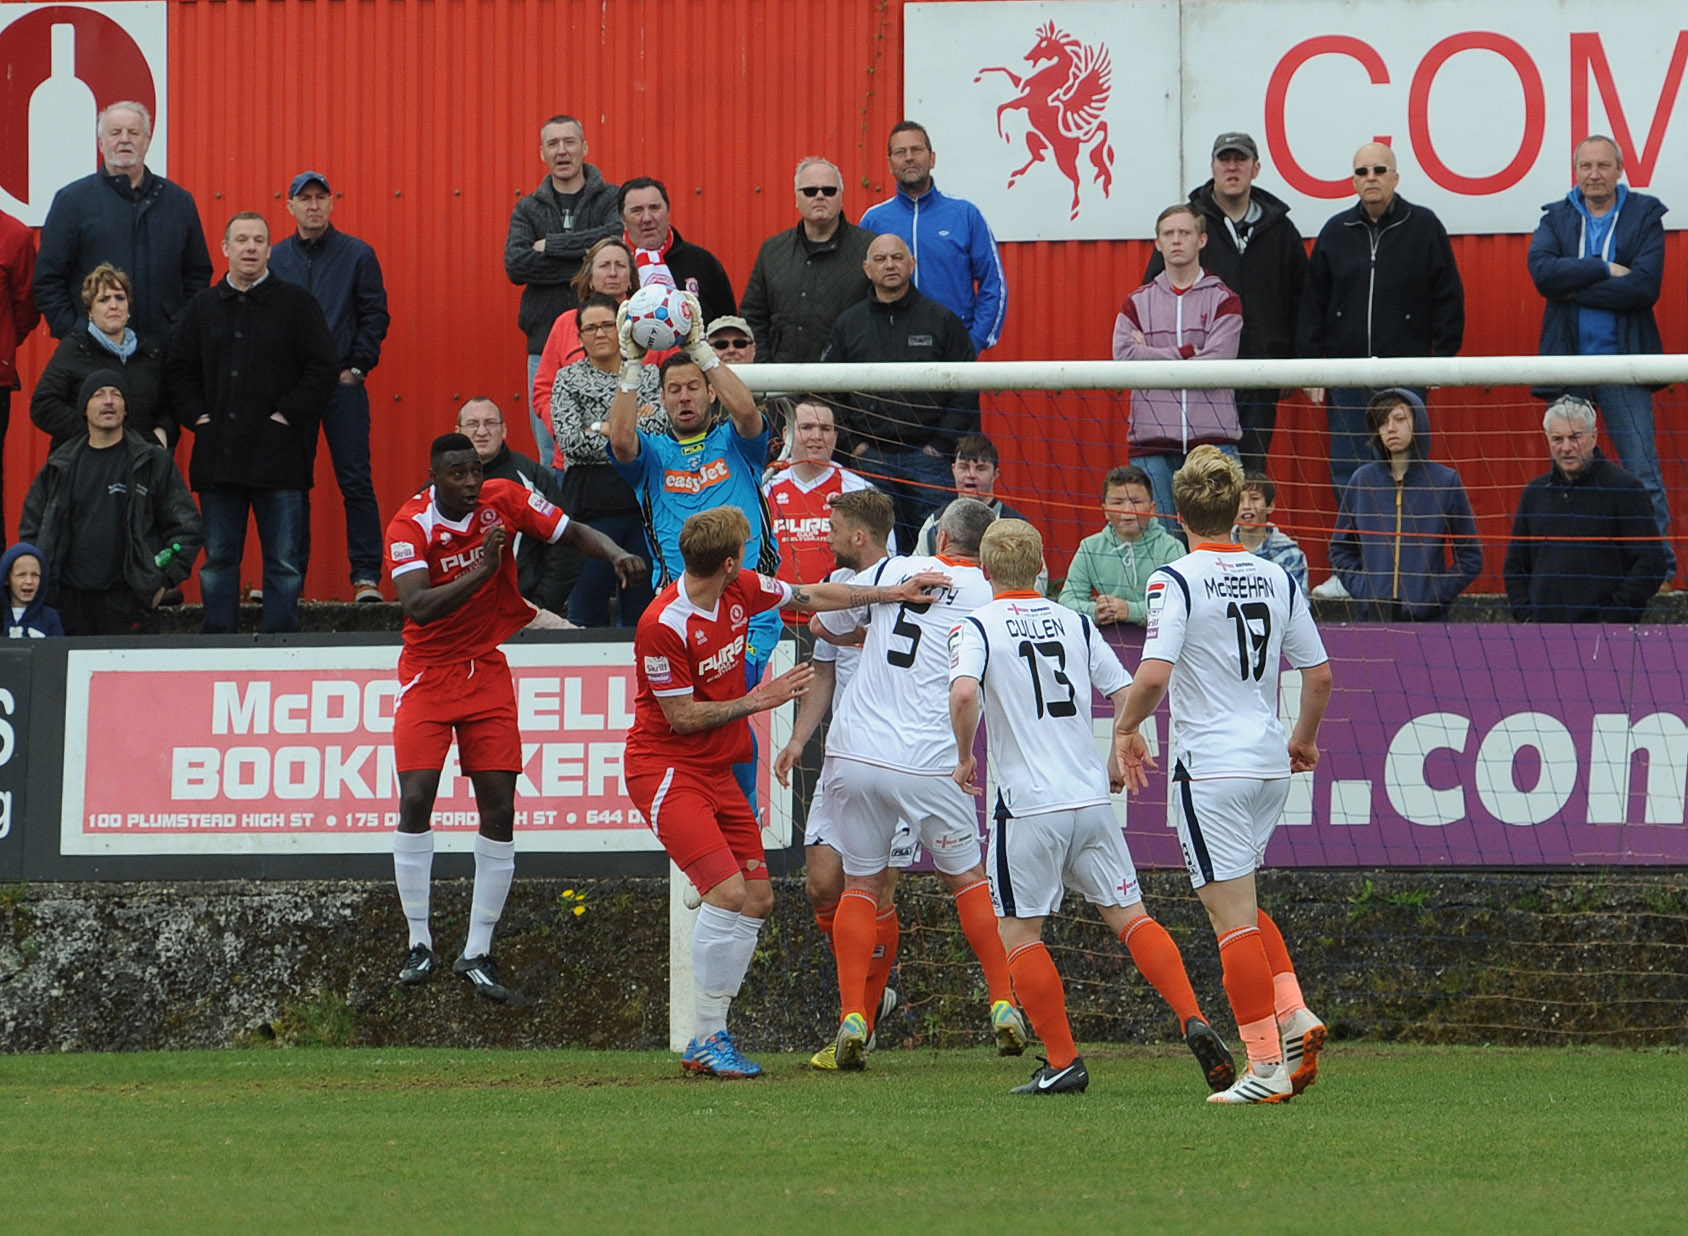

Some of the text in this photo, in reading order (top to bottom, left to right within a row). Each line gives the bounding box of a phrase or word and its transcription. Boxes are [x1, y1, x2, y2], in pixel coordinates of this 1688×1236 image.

[666, 461, 728, 492] easyJet
[1204, 576, 1275, 599] McGEEHAN
[887, 601, 932, 669] 5
[1006, 618, 1066, 640] CULLEN
[1227, 602, 1271, 682] 19
[699, 634, 744, 676] PURE
[1019, 640, 1077, 720] 13
[212, 676, 636, 734] McDOELL
[89, 813, 122, 828] 100
[127, 813, 237, 828] PLUMSTEAD
[242, 812, 285, 827] HIGH
[290, 812, 314, 827] ST
[346, 812, 379, 827] 175
[533, 811, 557, 825] ST
[586, 810, 622, 824] 644
